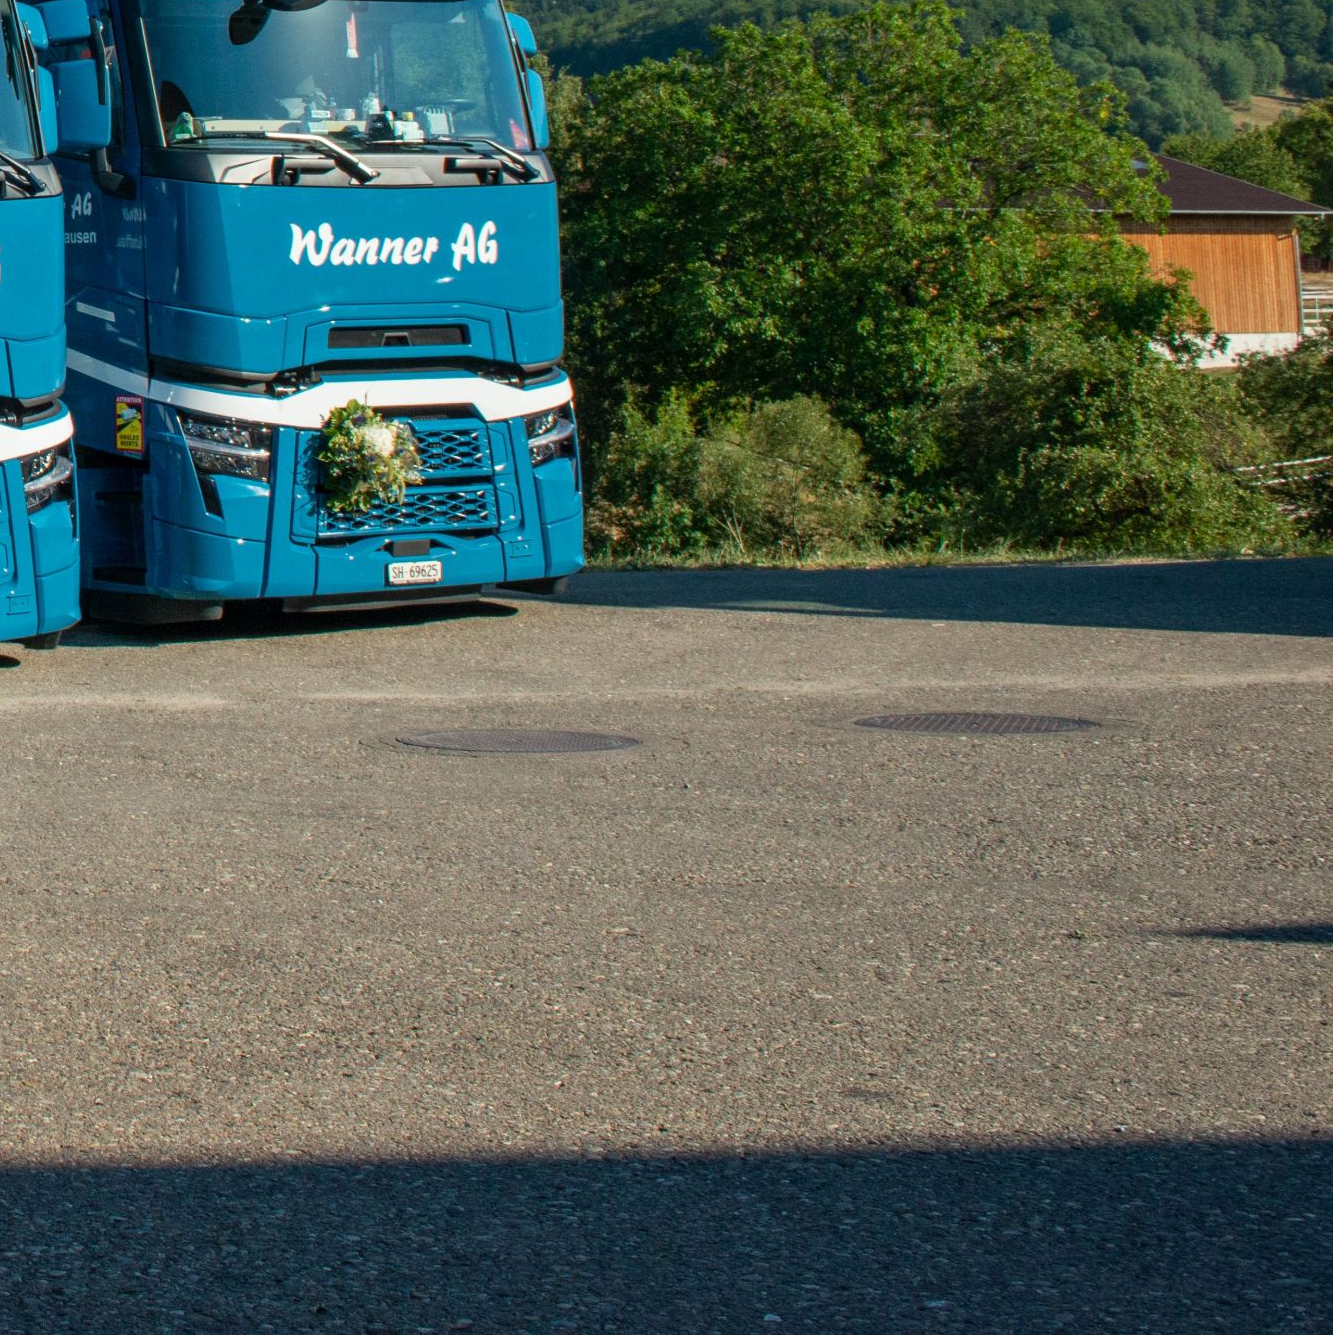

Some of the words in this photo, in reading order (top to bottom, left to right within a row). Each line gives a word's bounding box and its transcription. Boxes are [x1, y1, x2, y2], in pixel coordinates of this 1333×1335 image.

[71, 191, 92, 219] AG
[290, 222, 440, 266] Wanner
[451, 220, 498, 271] AG
